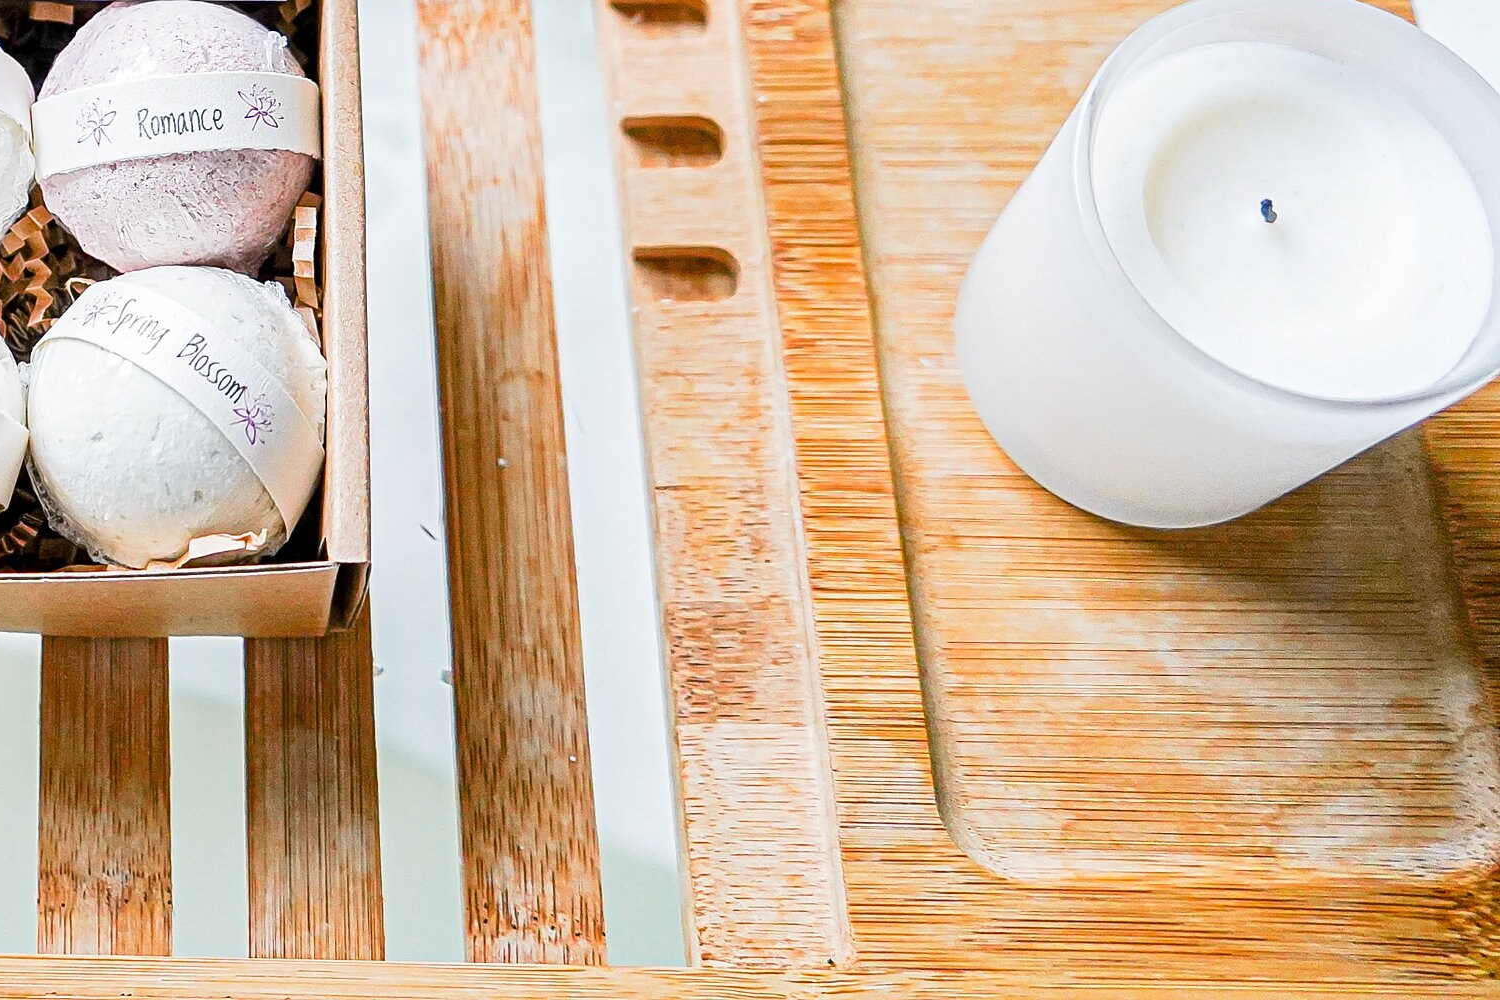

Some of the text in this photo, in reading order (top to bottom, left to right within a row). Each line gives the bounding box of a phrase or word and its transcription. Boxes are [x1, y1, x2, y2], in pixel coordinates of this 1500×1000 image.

[137, 107, 224, 140] Romance
[107, 298, 247, 404] Spring Blossom
